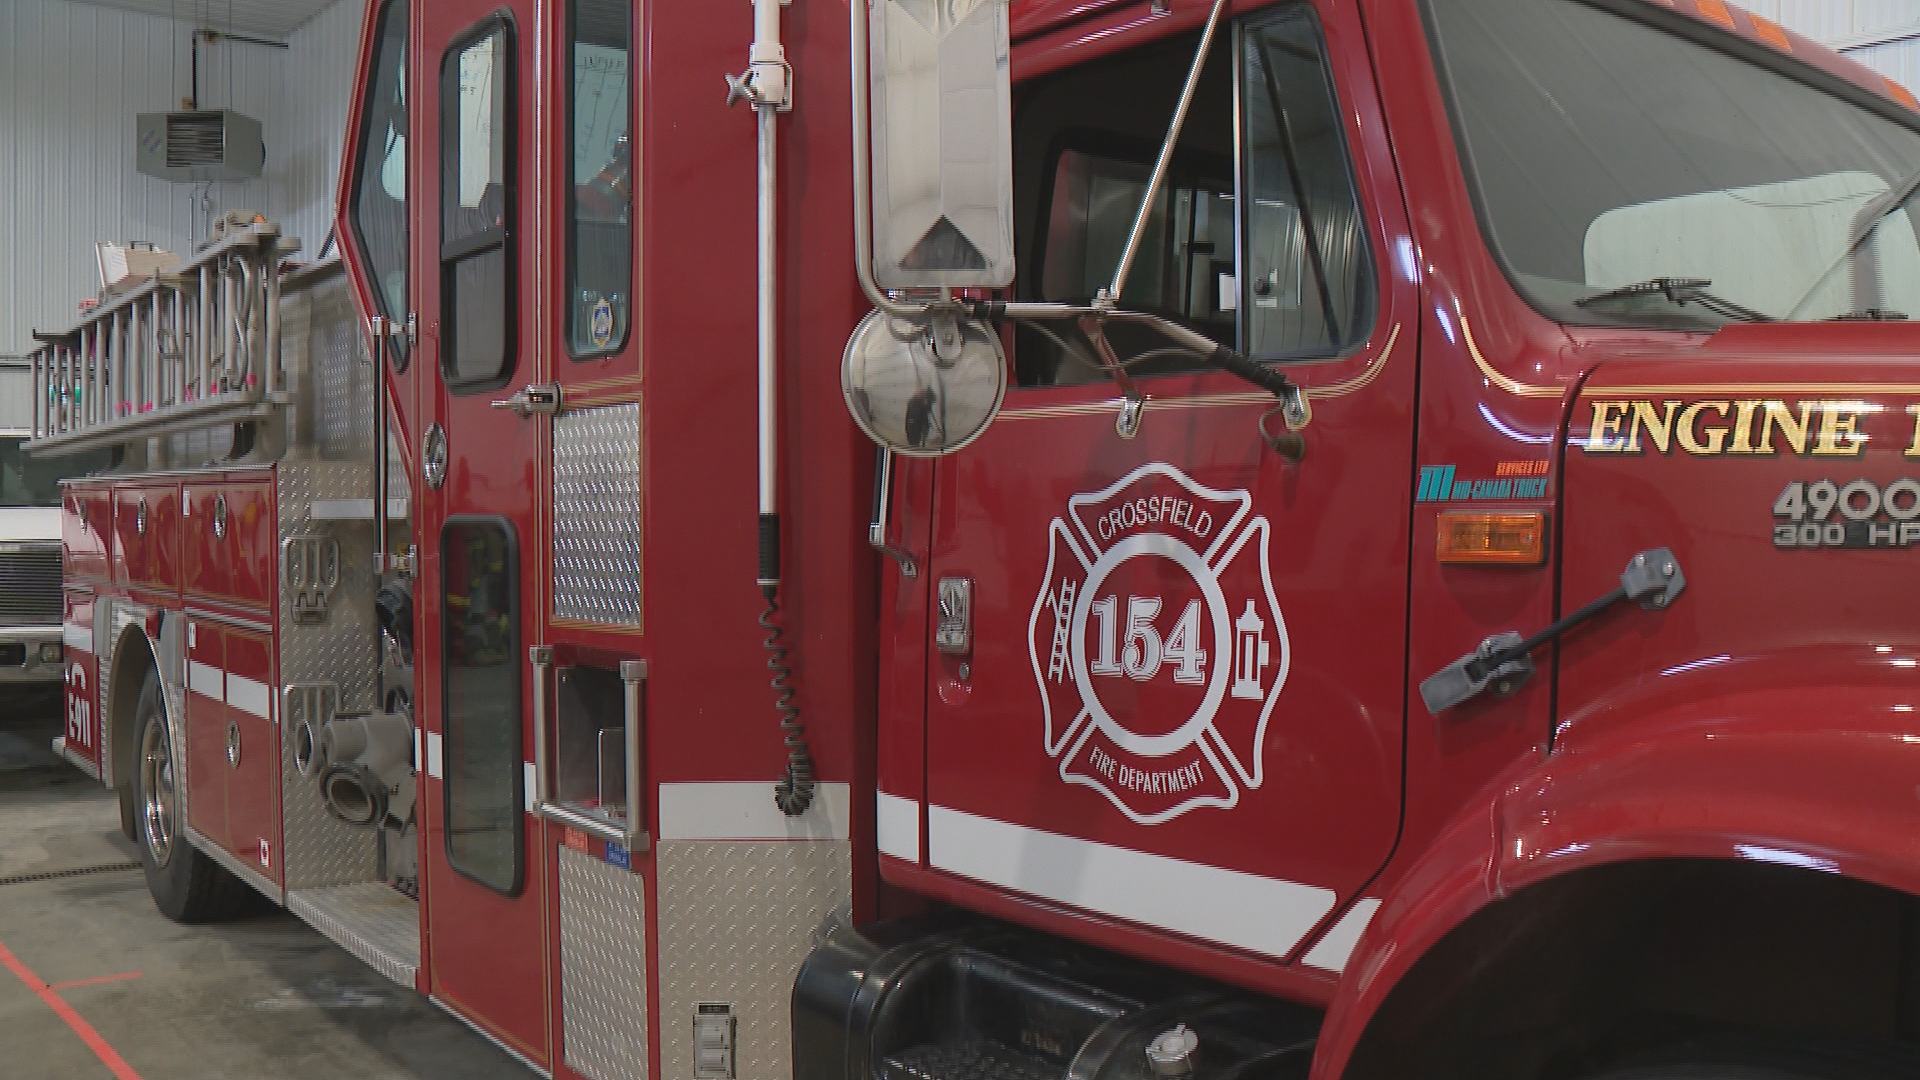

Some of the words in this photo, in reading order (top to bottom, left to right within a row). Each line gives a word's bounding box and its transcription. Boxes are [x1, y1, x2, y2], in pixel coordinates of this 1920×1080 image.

[1584, 400, 1868, 455] ENGINE
[1098, 496, 1212, 539] CROSSFIELD
[1772, 479, 1920, 521] 4900
[1773, 524, 1846, 546] 300
[1091, 595, 1207, 685] 154
[1089, 745, 1118, 781] FIRE
[1119, 759, 1204, 793] DEPARTMENT
